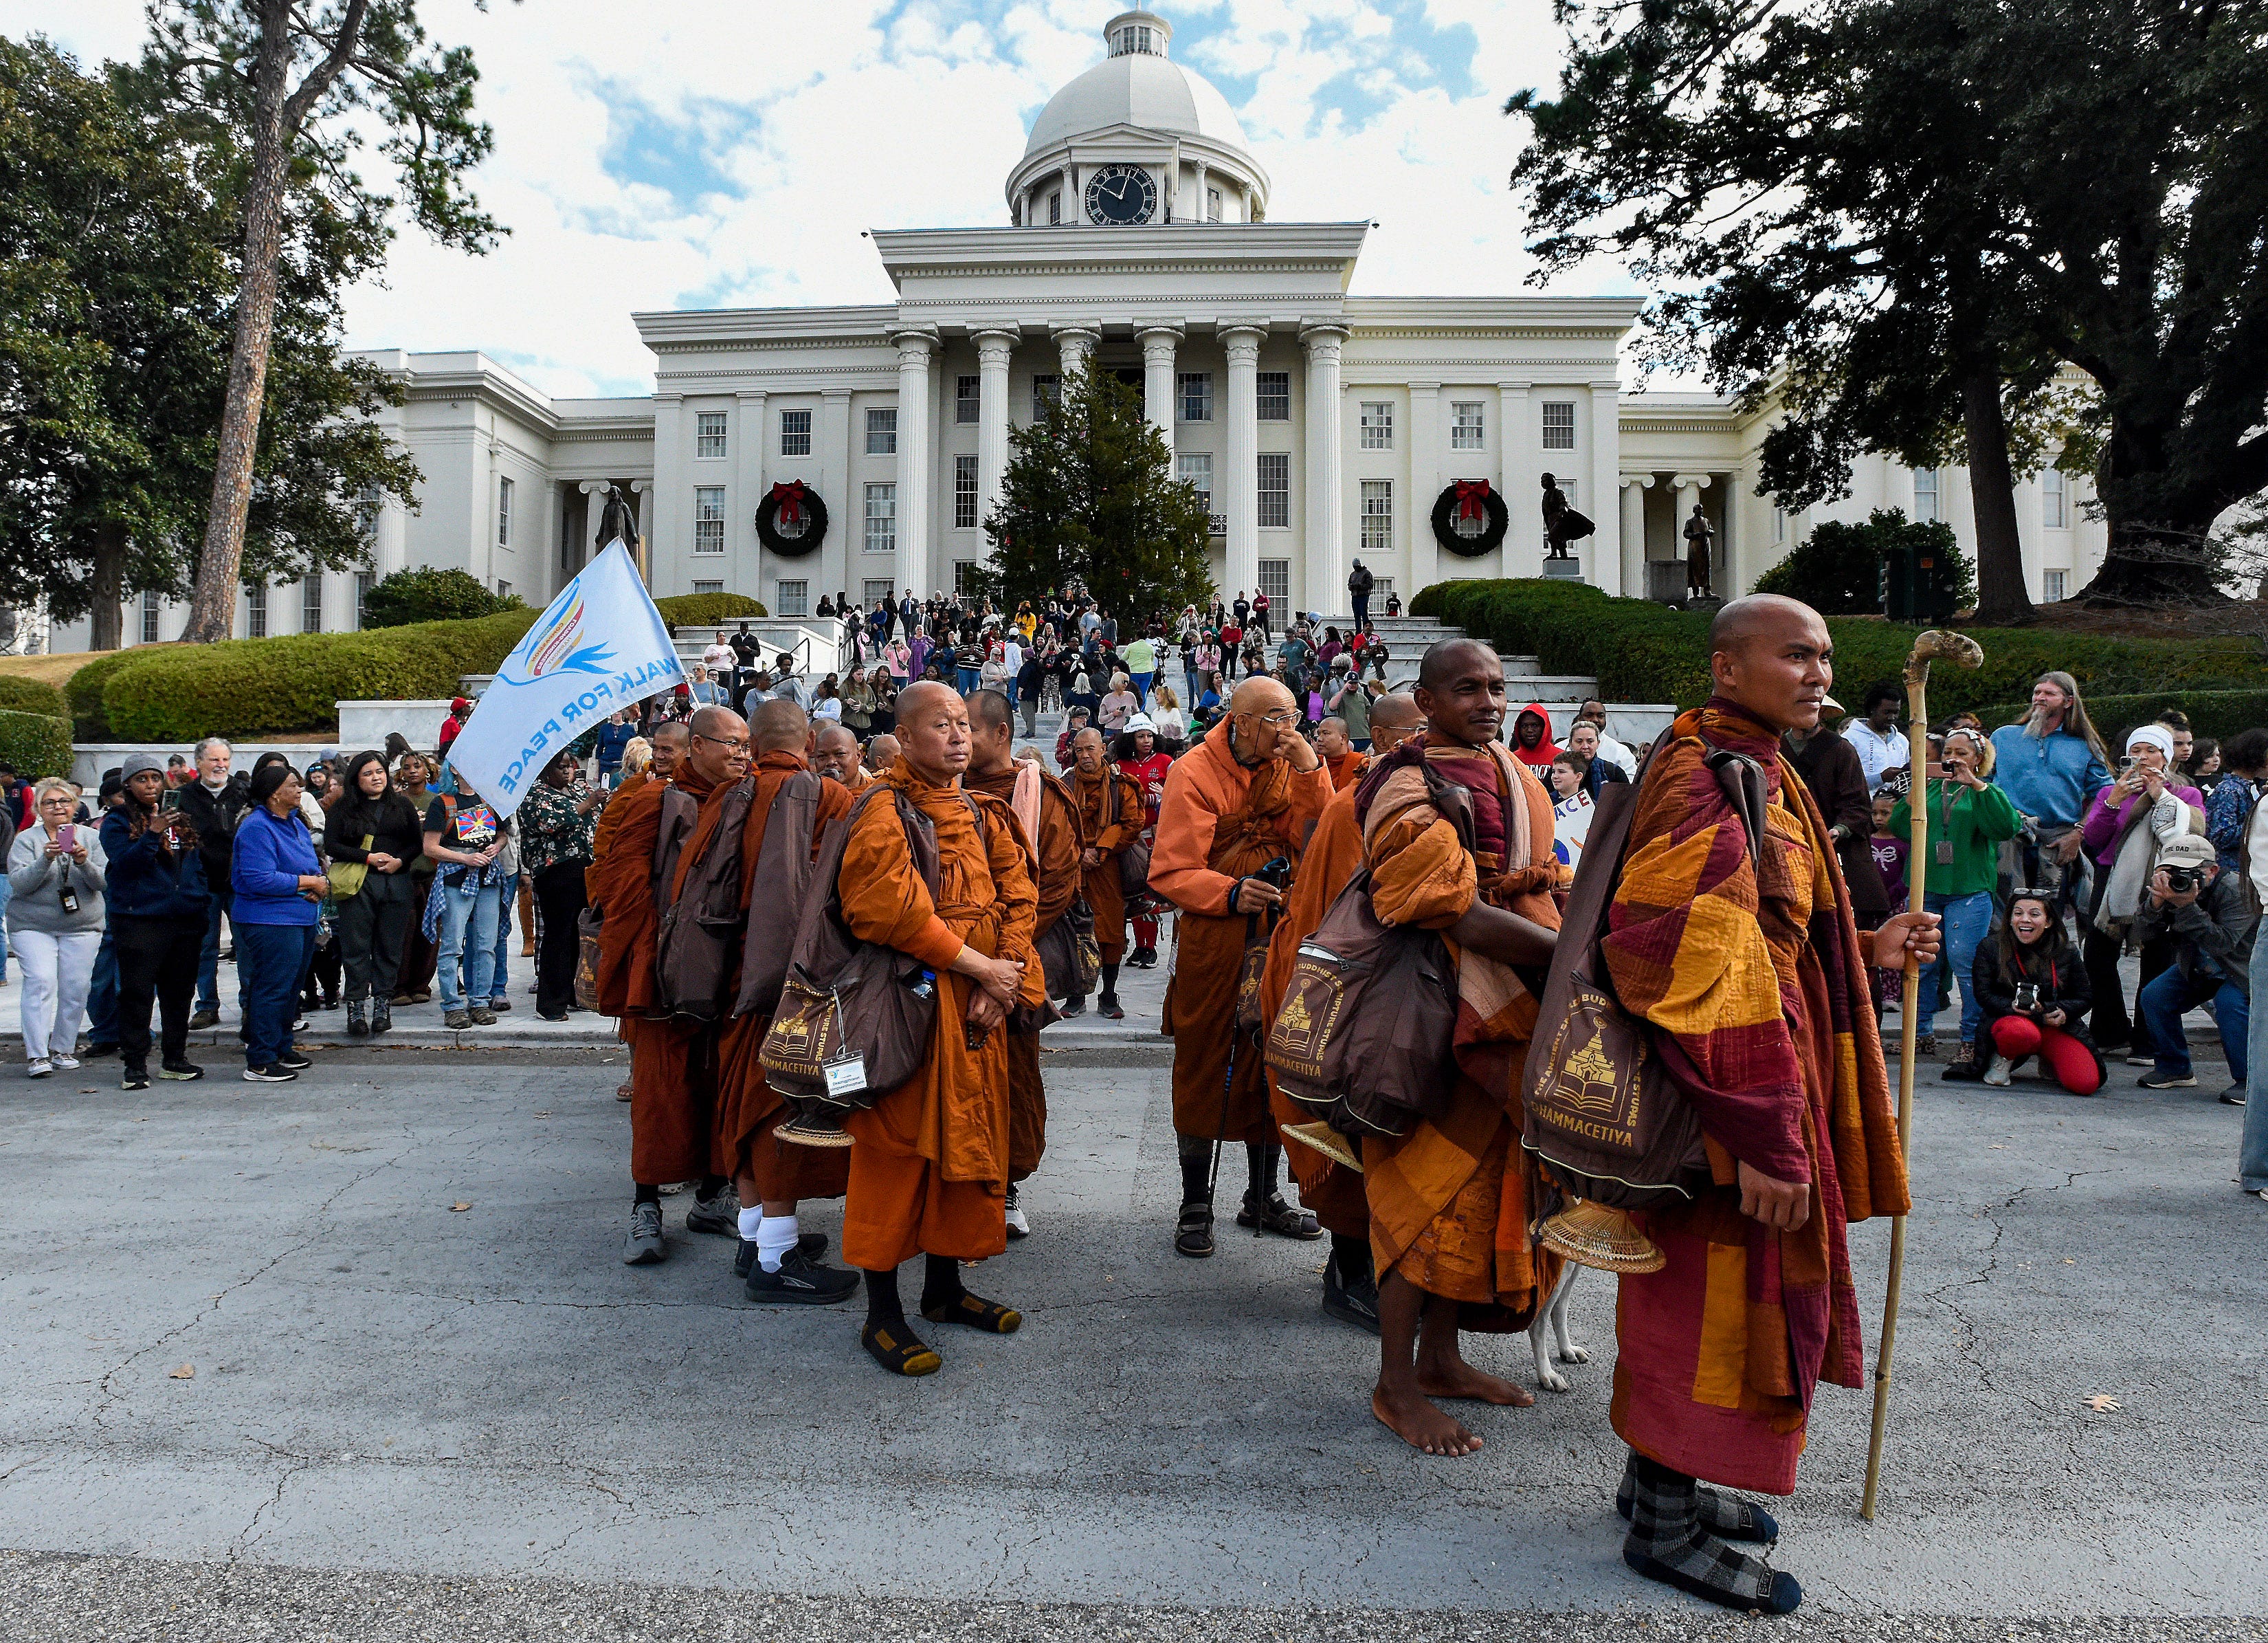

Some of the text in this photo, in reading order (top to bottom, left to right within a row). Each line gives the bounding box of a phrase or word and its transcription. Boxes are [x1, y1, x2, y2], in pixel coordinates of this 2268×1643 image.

[1554, 791, 1590, 822] ACE
[815, 1033, 827, 1061] STUPAS
[1531, 1101, 1633, 1147] DHAMMACETIYA
